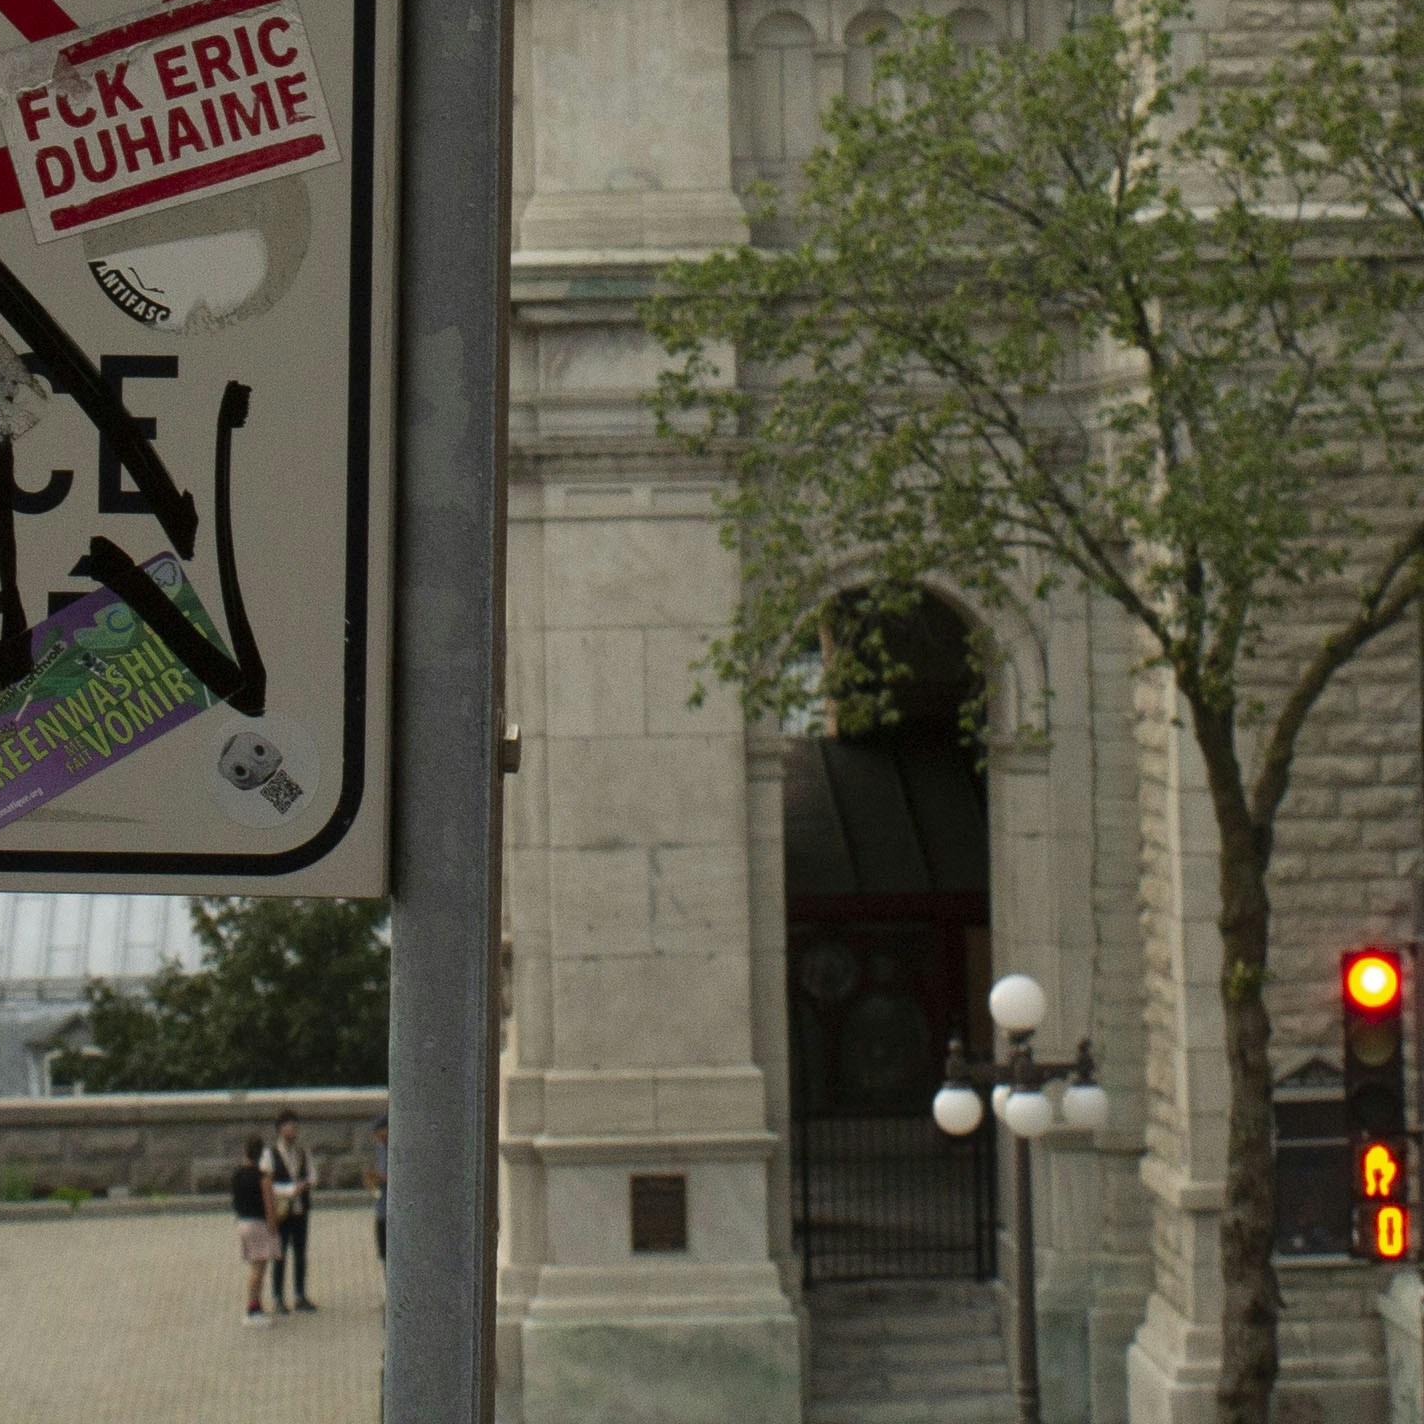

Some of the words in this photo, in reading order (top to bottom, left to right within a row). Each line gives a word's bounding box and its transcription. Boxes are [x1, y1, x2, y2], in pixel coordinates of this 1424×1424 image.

[16, 62, 144, 142] FCK
[153, 16, 299, 101] ERIC
[34, 71, 317, 199] DUHAIME
[17, 643, 66, 691] northvolt
[79, 666, 197, 760] VOMIR
